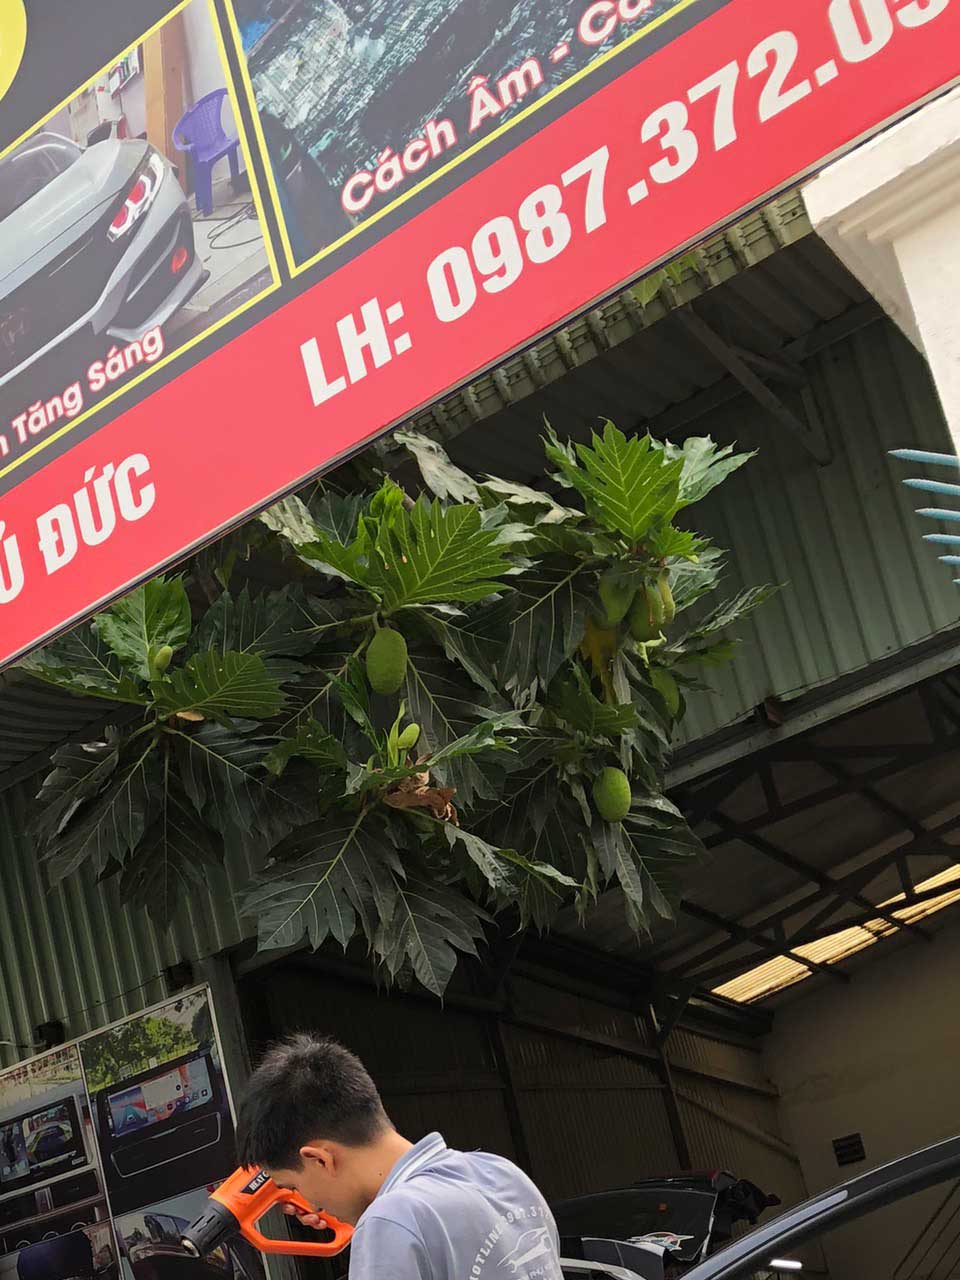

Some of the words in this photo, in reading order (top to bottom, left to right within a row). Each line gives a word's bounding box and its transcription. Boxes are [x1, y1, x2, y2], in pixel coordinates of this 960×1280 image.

[341, 118, 457, 214] Cách
[468, 55, 544, 133] Âm
[11, 381, 84, 444] Tăng
[87, 324, 165, 392] Sáng
[299, 298, 412, 407] LH:
[36, 453, 156, 576] ĐỨC
